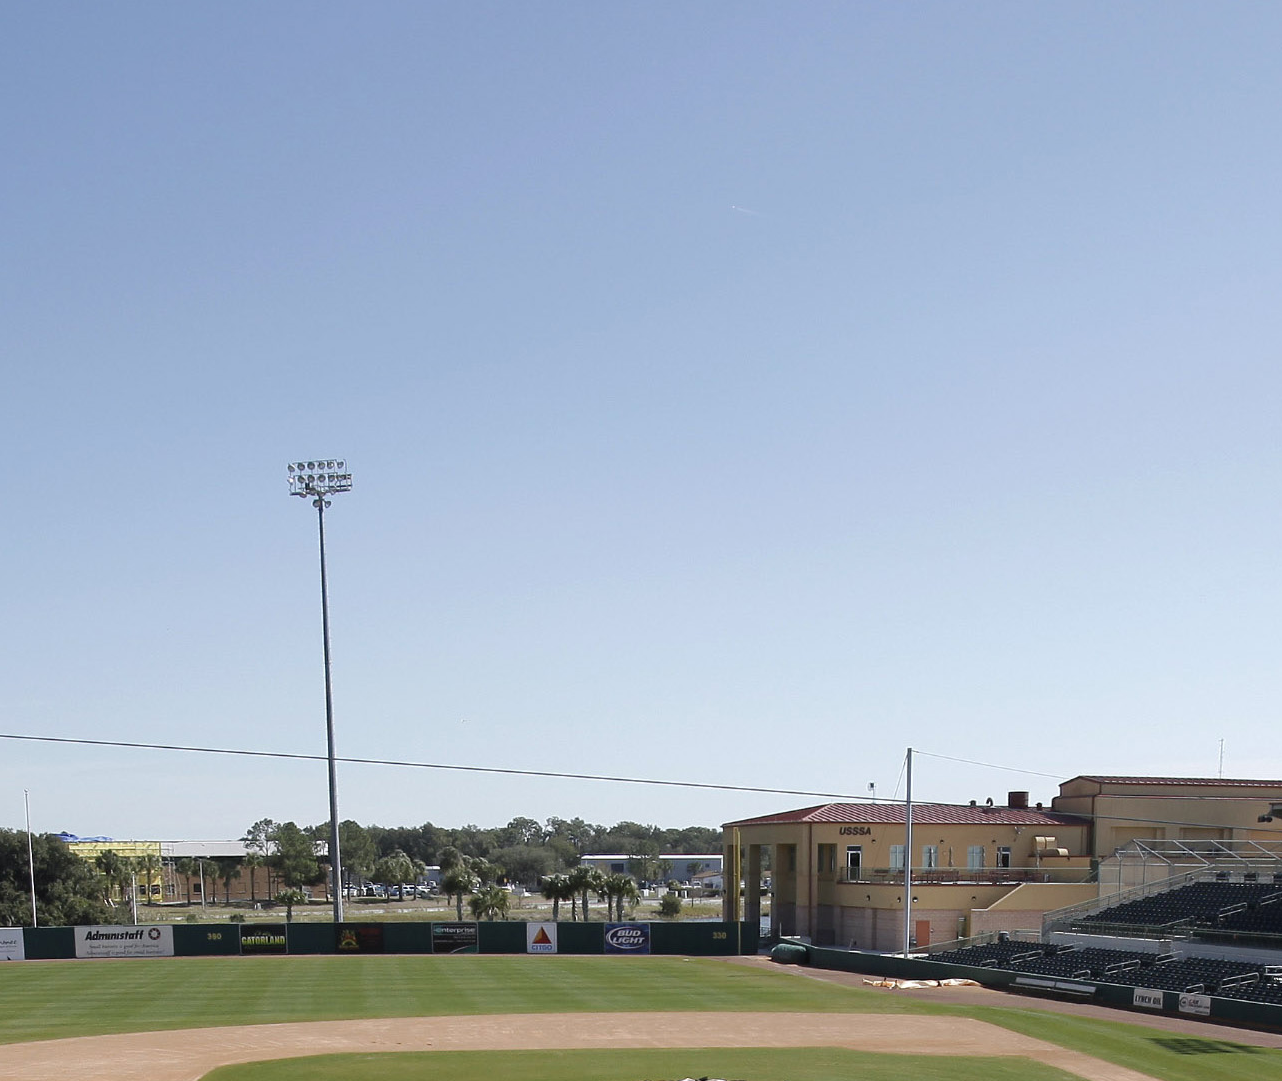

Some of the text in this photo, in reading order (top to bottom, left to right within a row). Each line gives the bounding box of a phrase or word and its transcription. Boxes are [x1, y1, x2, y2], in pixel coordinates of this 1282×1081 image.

[839, 826, 871, 836] USSSA
[85, 930, 144, 941] Administaff
[617, 929, 641, 937] BUD
[241, 936, 286, 945] GATORLAND
